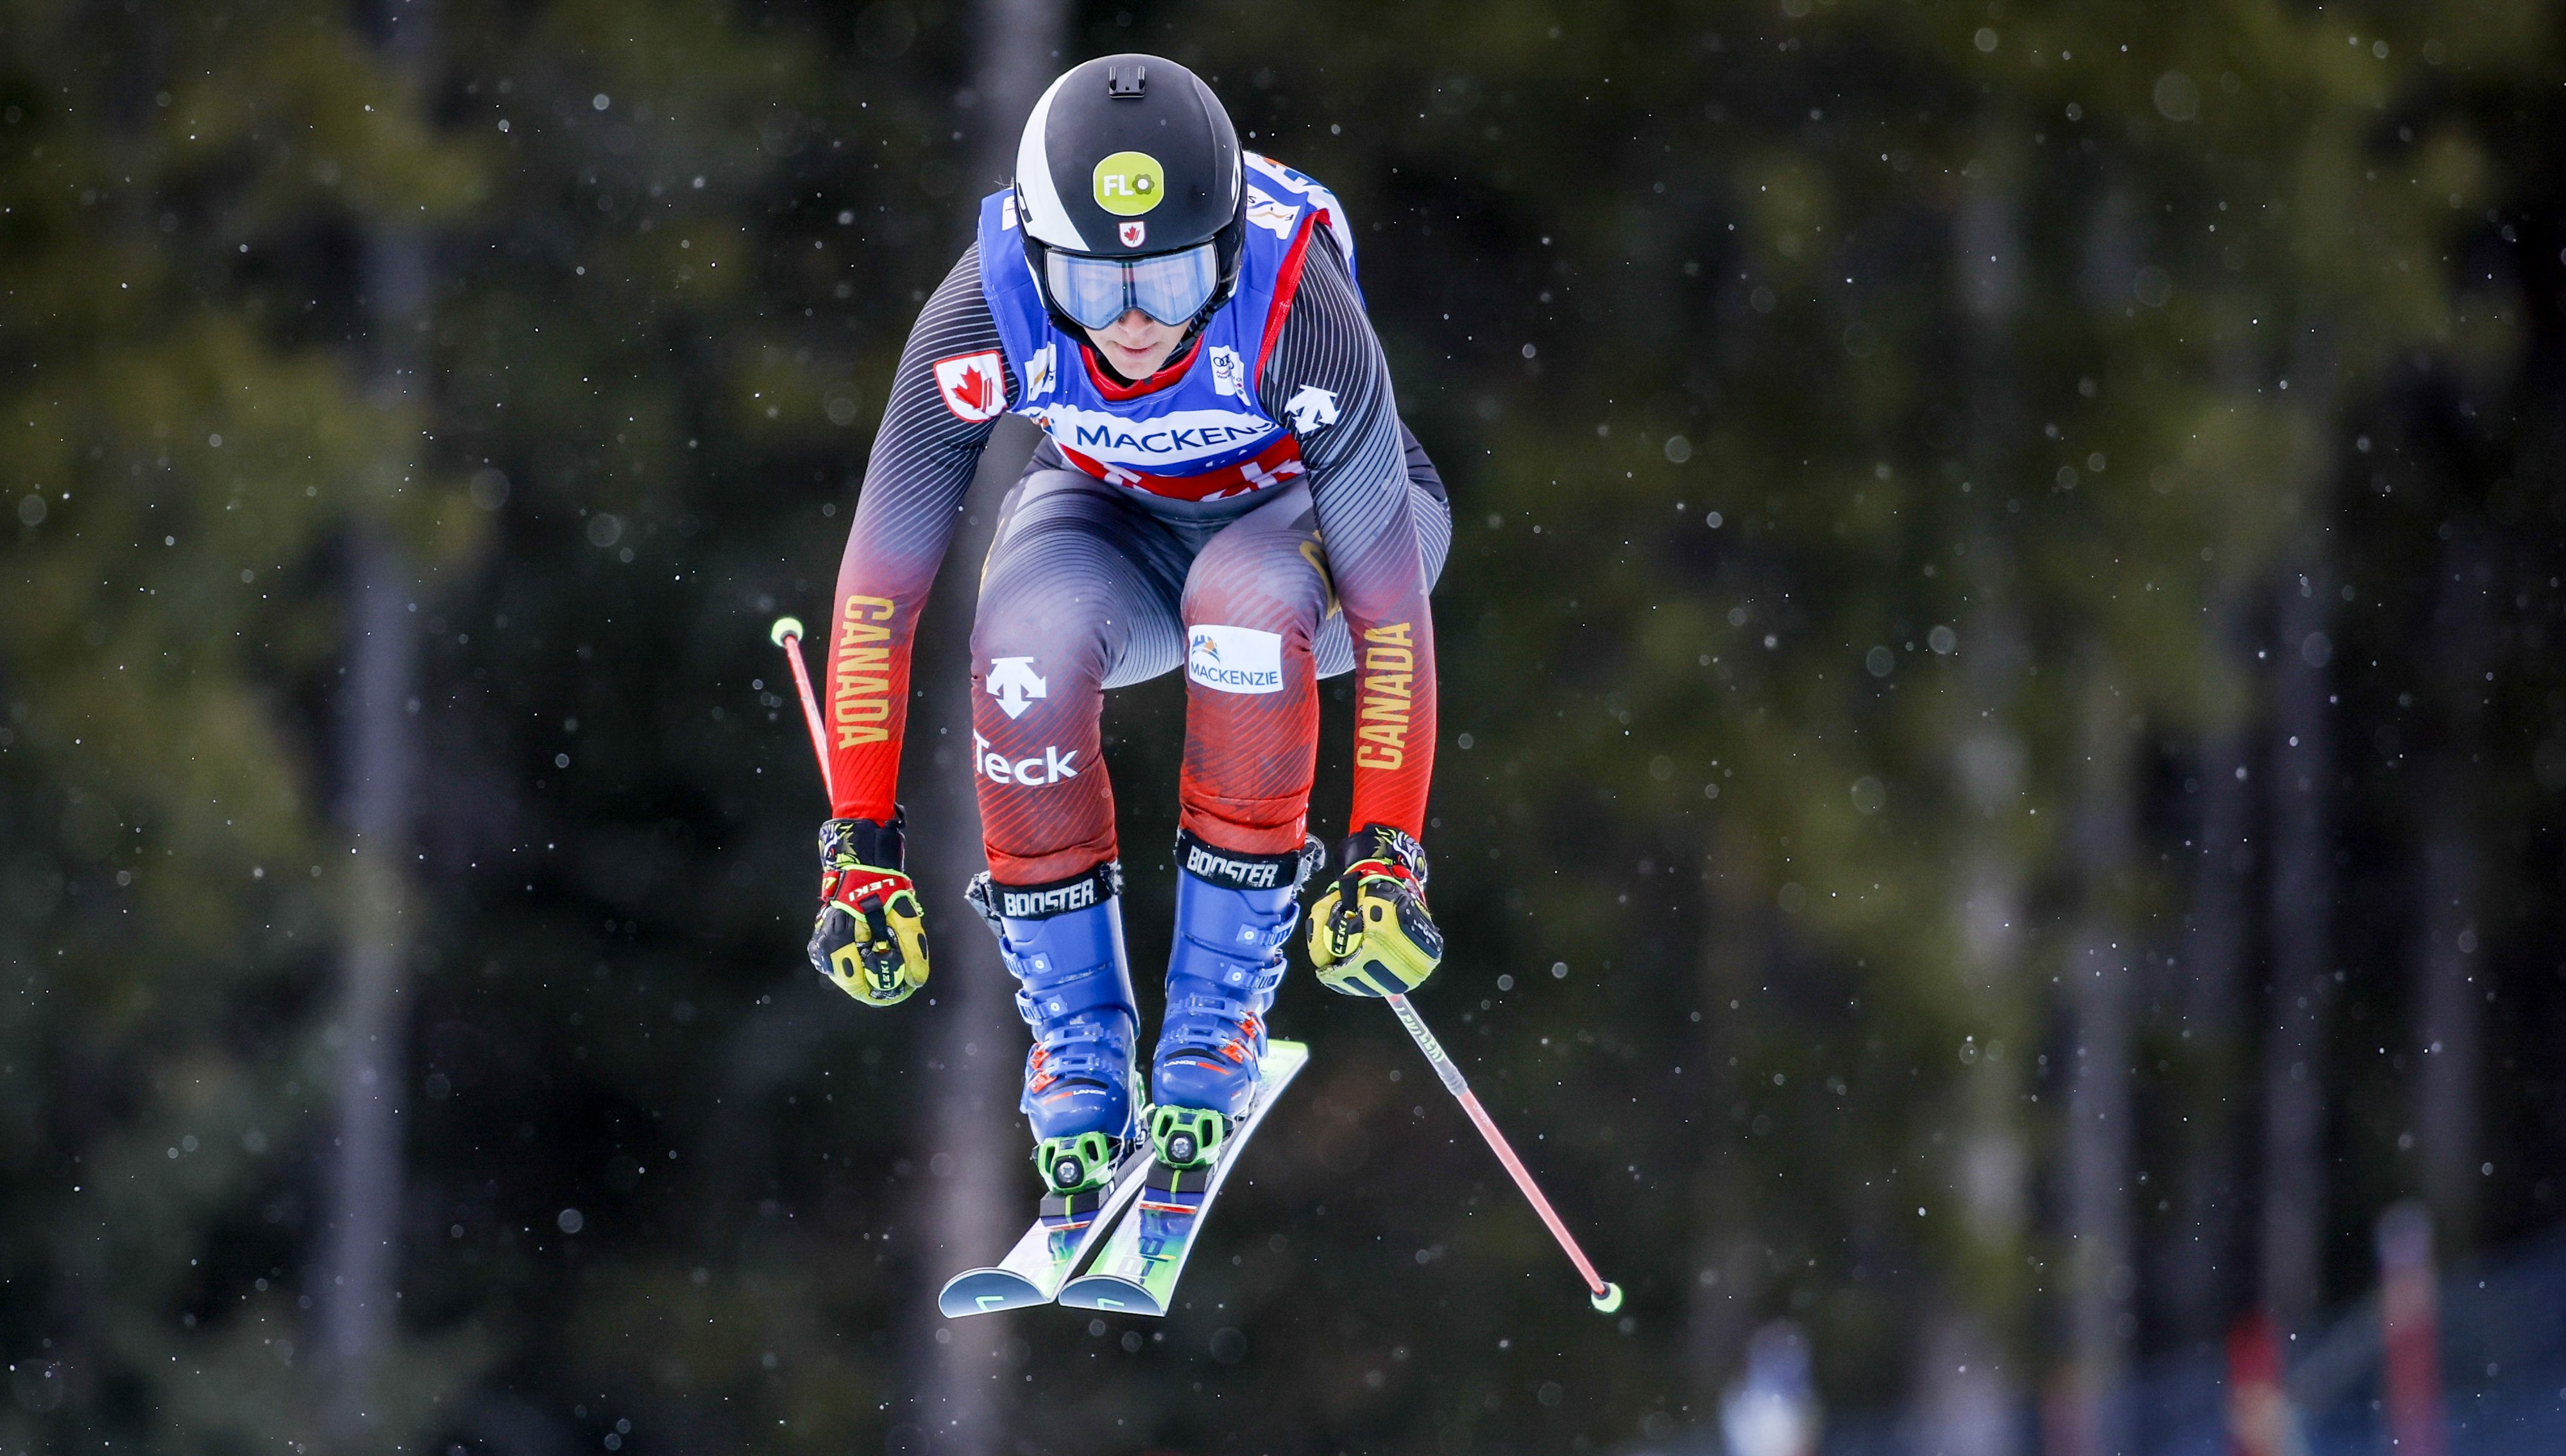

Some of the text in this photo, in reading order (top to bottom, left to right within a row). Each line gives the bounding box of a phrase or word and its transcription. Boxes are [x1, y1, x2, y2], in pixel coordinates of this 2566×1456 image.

[835, 595, 894, 750] CANADA
[1191, 661, 1279, 686] MACKENZIE
[1356, 622, 1413, 770] CANADA
[973, 729, 1079, 786] Teck
[1187, 845, 1279, 888] BOOSTER
[848, 877, 895, 902] LEKI
[1003, 877, 1095, 917] BOOSTER
[1334, 920, 1347, 954] LEKI
[881, 960, 891, 988] LEKI
